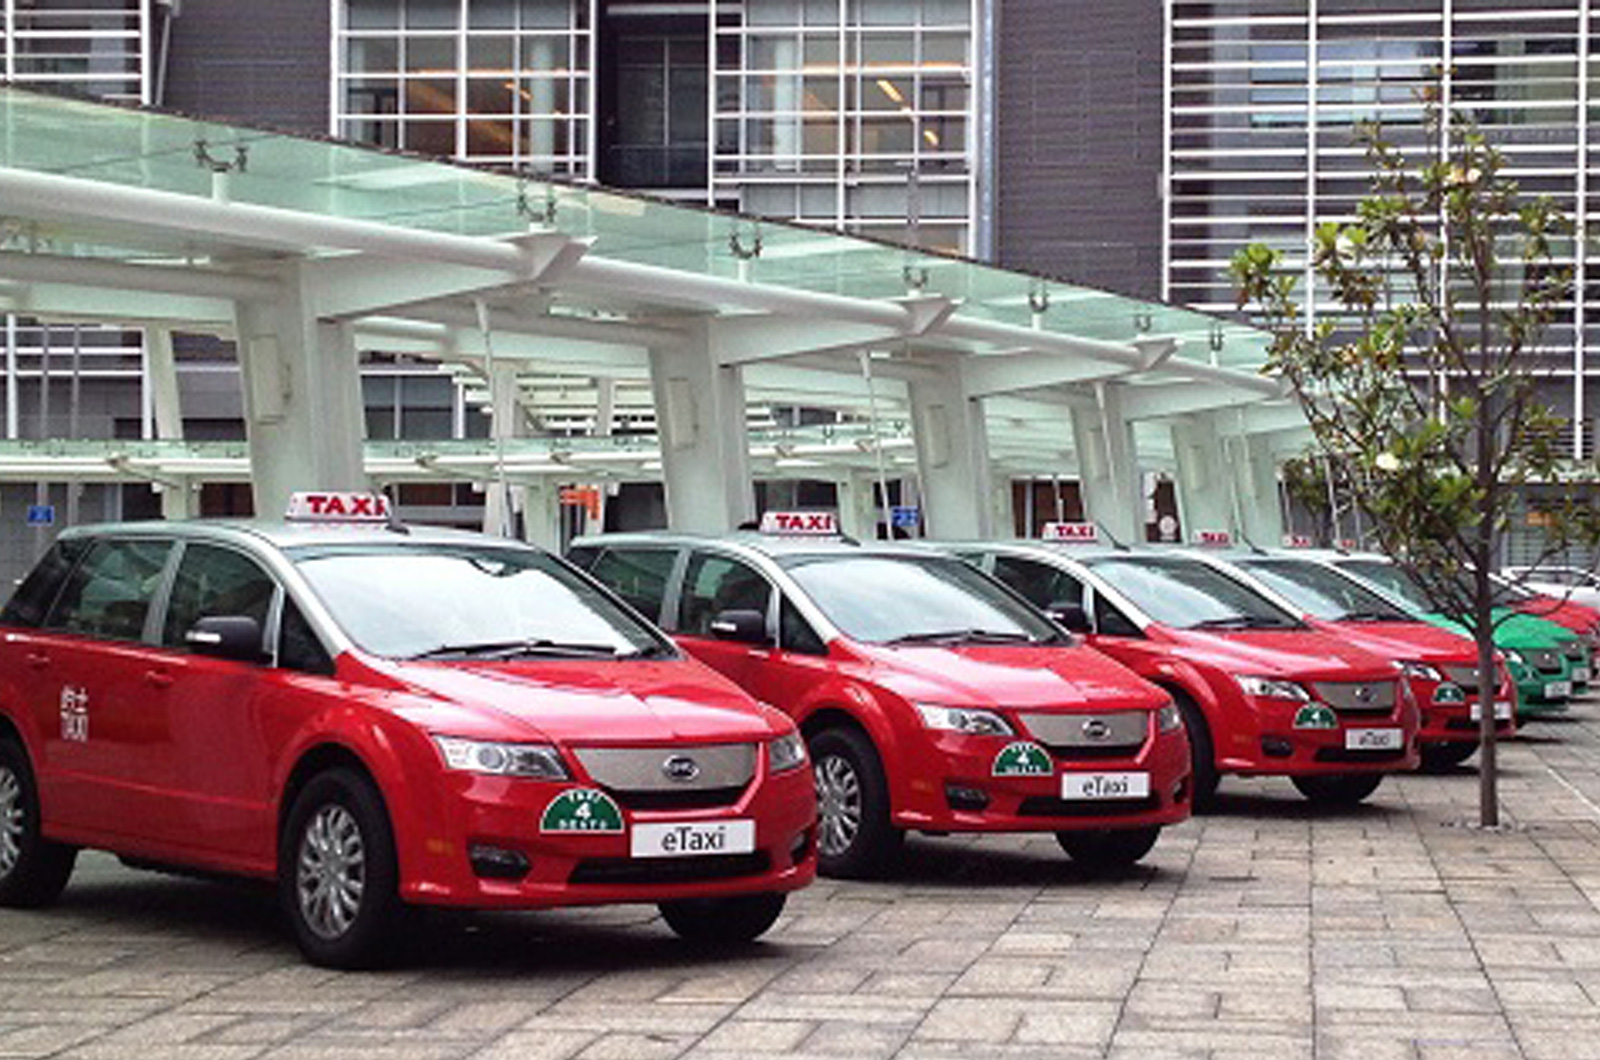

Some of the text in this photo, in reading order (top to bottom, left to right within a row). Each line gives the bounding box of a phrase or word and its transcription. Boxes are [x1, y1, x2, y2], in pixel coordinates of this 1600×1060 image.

[306, 496, 385, 514] TAXI
[775, 514, 831, 529] TAXI
[1056, 525, 1094, 537] TAXI
[1017, 752, 1030, 764] 4
[1082, 776, 1129, 796] eTaxi
[575, 802, 592, 819] 4
[661, 826, 726, 851] eTaxi
